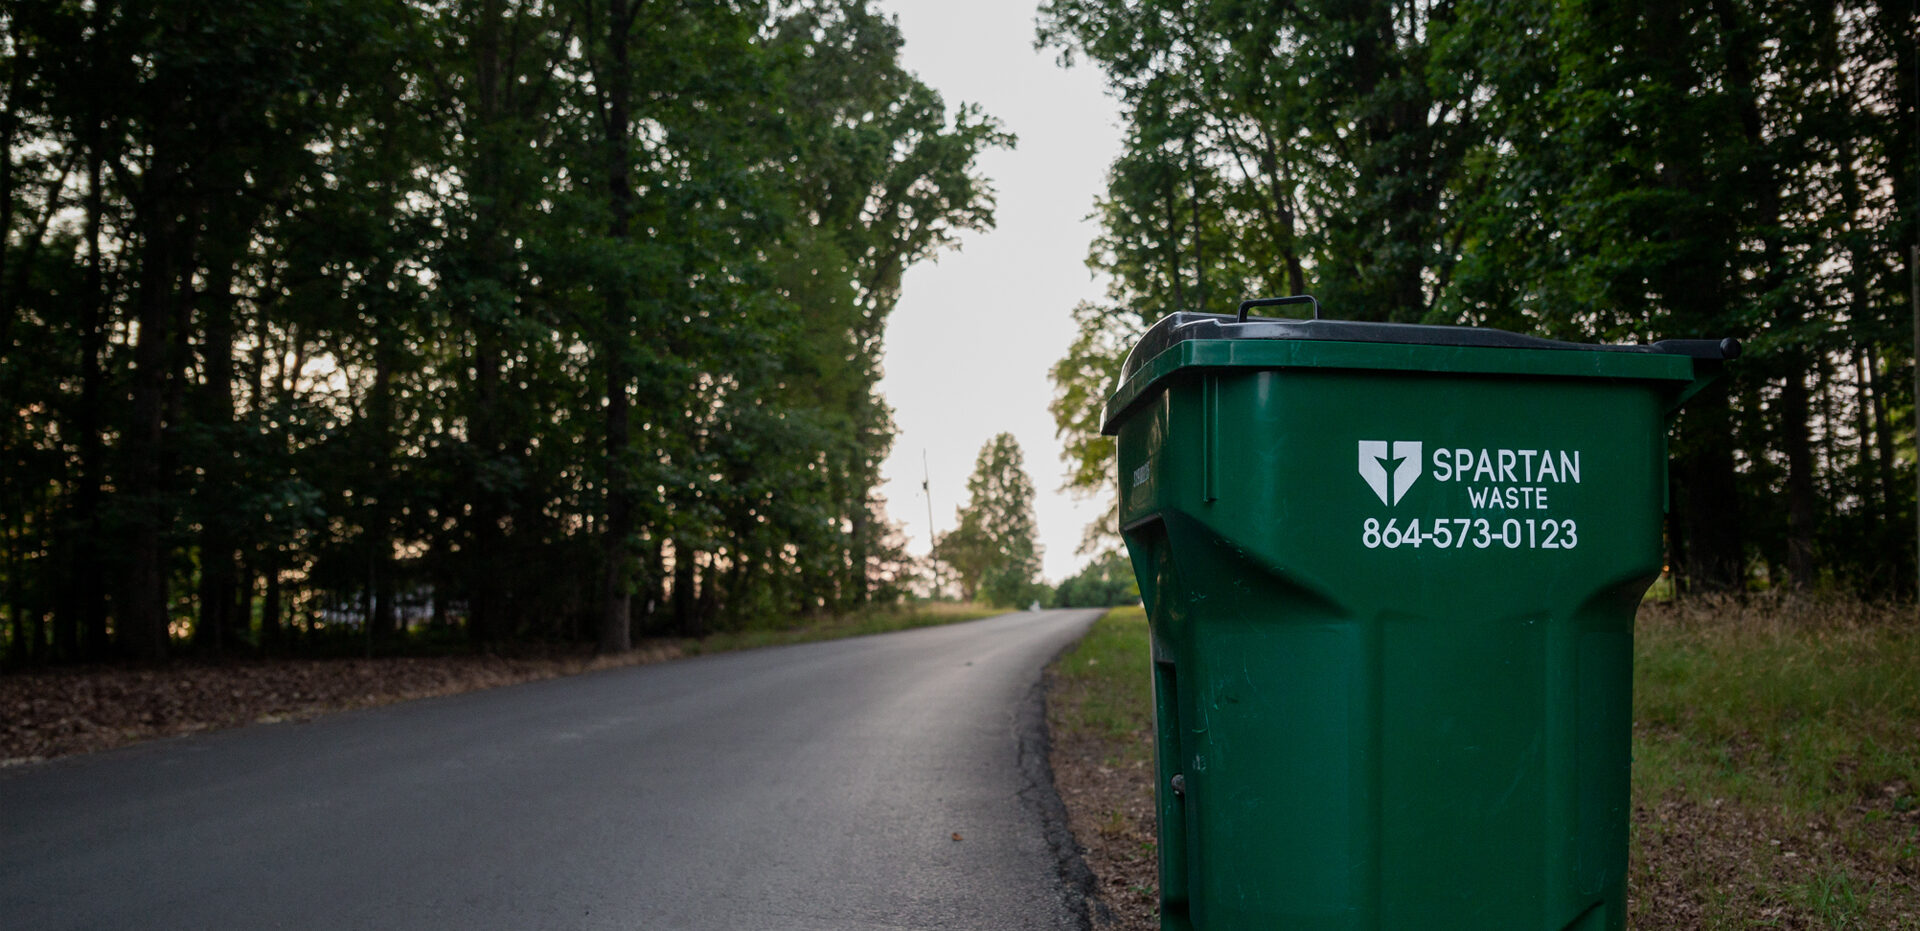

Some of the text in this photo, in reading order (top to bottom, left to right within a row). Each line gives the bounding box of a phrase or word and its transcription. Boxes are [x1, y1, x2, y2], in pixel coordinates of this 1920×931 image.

[1433, 448, 1580, 483] SPARTAN
[1468, 487, 1548, 509] WASTE
[1363, 518, 1578, 549] 864-573-0123
